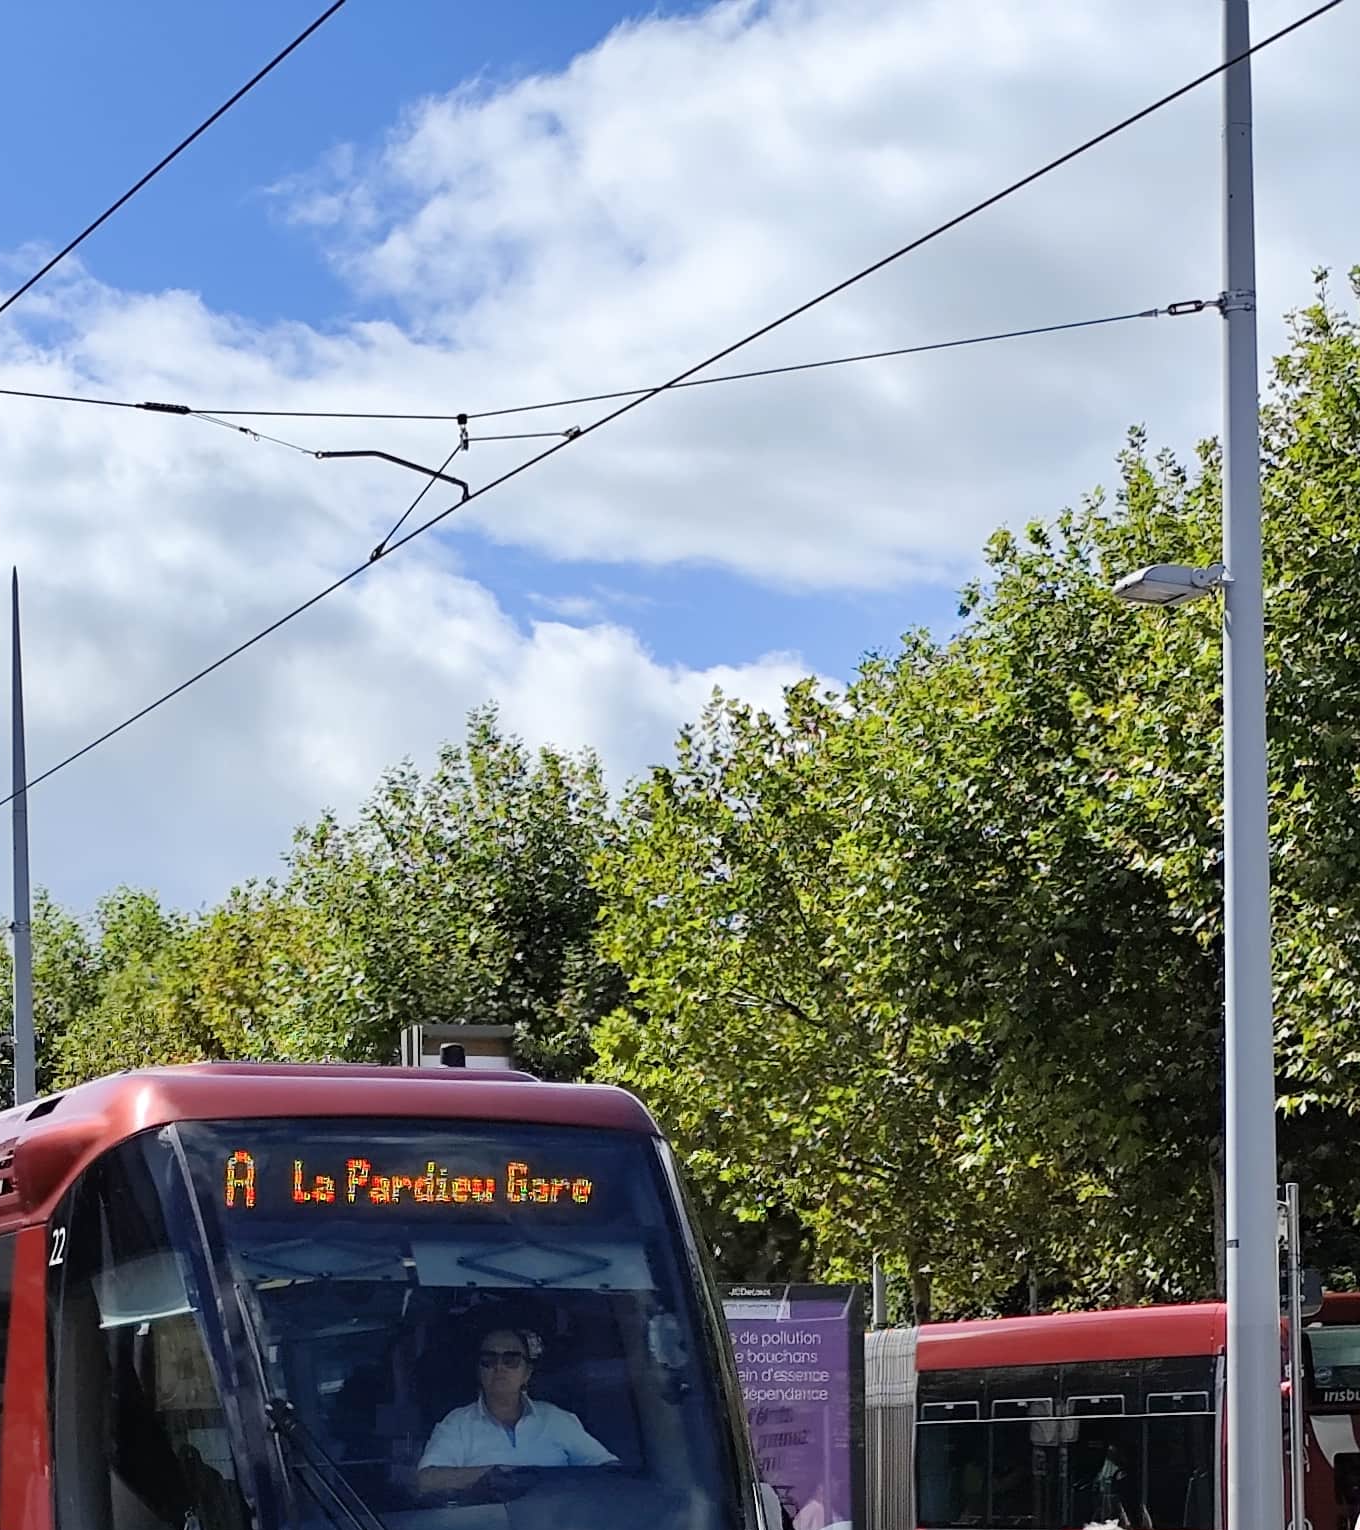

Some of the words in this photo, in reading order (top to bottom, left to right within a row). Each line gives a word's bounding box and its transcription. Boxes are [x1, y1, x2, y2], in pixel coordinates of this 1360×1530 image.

[226, 1150, 256, 1208] A
[293, 1160, 335, 1203] La
[346, 1157, 496, 1204] Pardieu
[506, 1161, 592, 1204] Gare
[48, 1226, 66, 1266] 22
[740, 1331, 759, 1345] de
[761, 1331, 822, 1347] pollution
